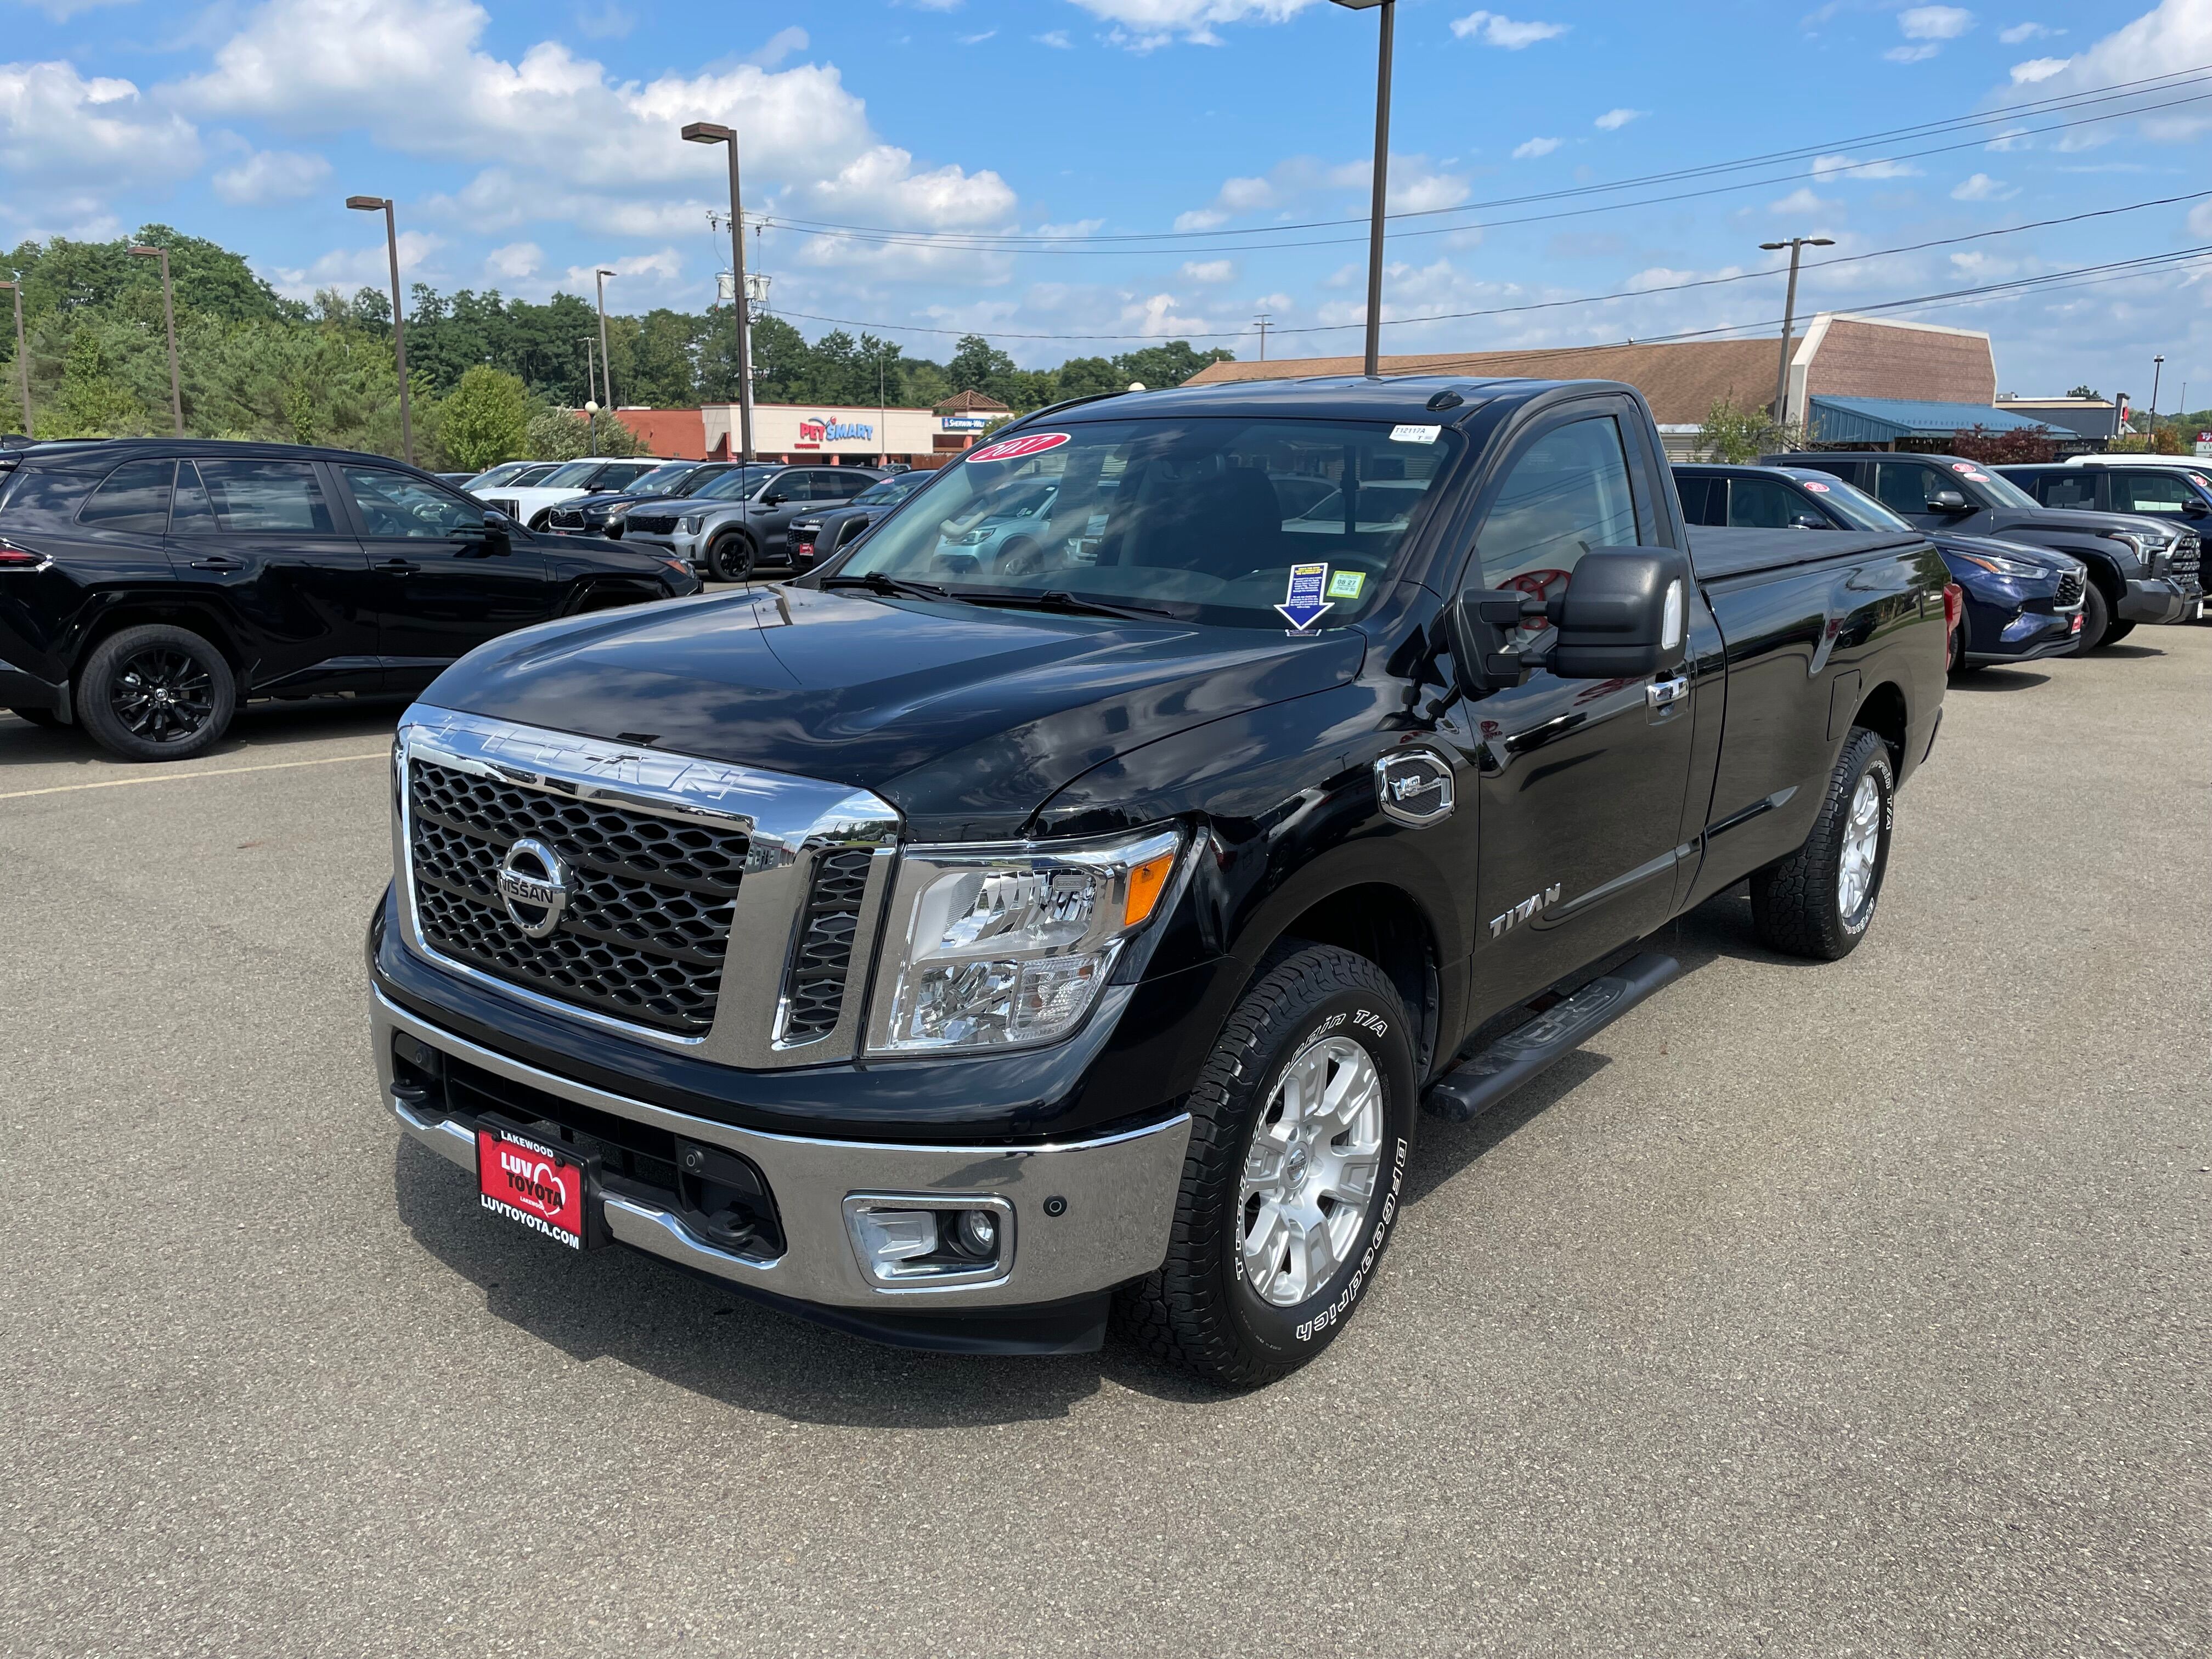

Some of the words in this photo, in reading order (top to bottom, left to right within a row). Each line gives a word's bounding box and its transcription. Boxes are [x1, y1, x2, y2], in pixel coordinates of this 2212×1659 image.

[800, 421, 873, 441] PETSMART
[974, 435, 1058, 460] 2017
[500, 878, 554, 904] NISSAN
[1489, 883, 1561, 939] TITAN
[1353, 1009, 1389, 1039] T/A
[500, 1130, 554, 1158] LAKEWOOD
[500, 1152, 533, 1178] LUV
[506, 1171, 564, 1210] TOYOTA
[481, 1194, 579, 1250] LUVTOYOTA.COM
[1295, 1137, 1408, 1342] BFGoodrich
